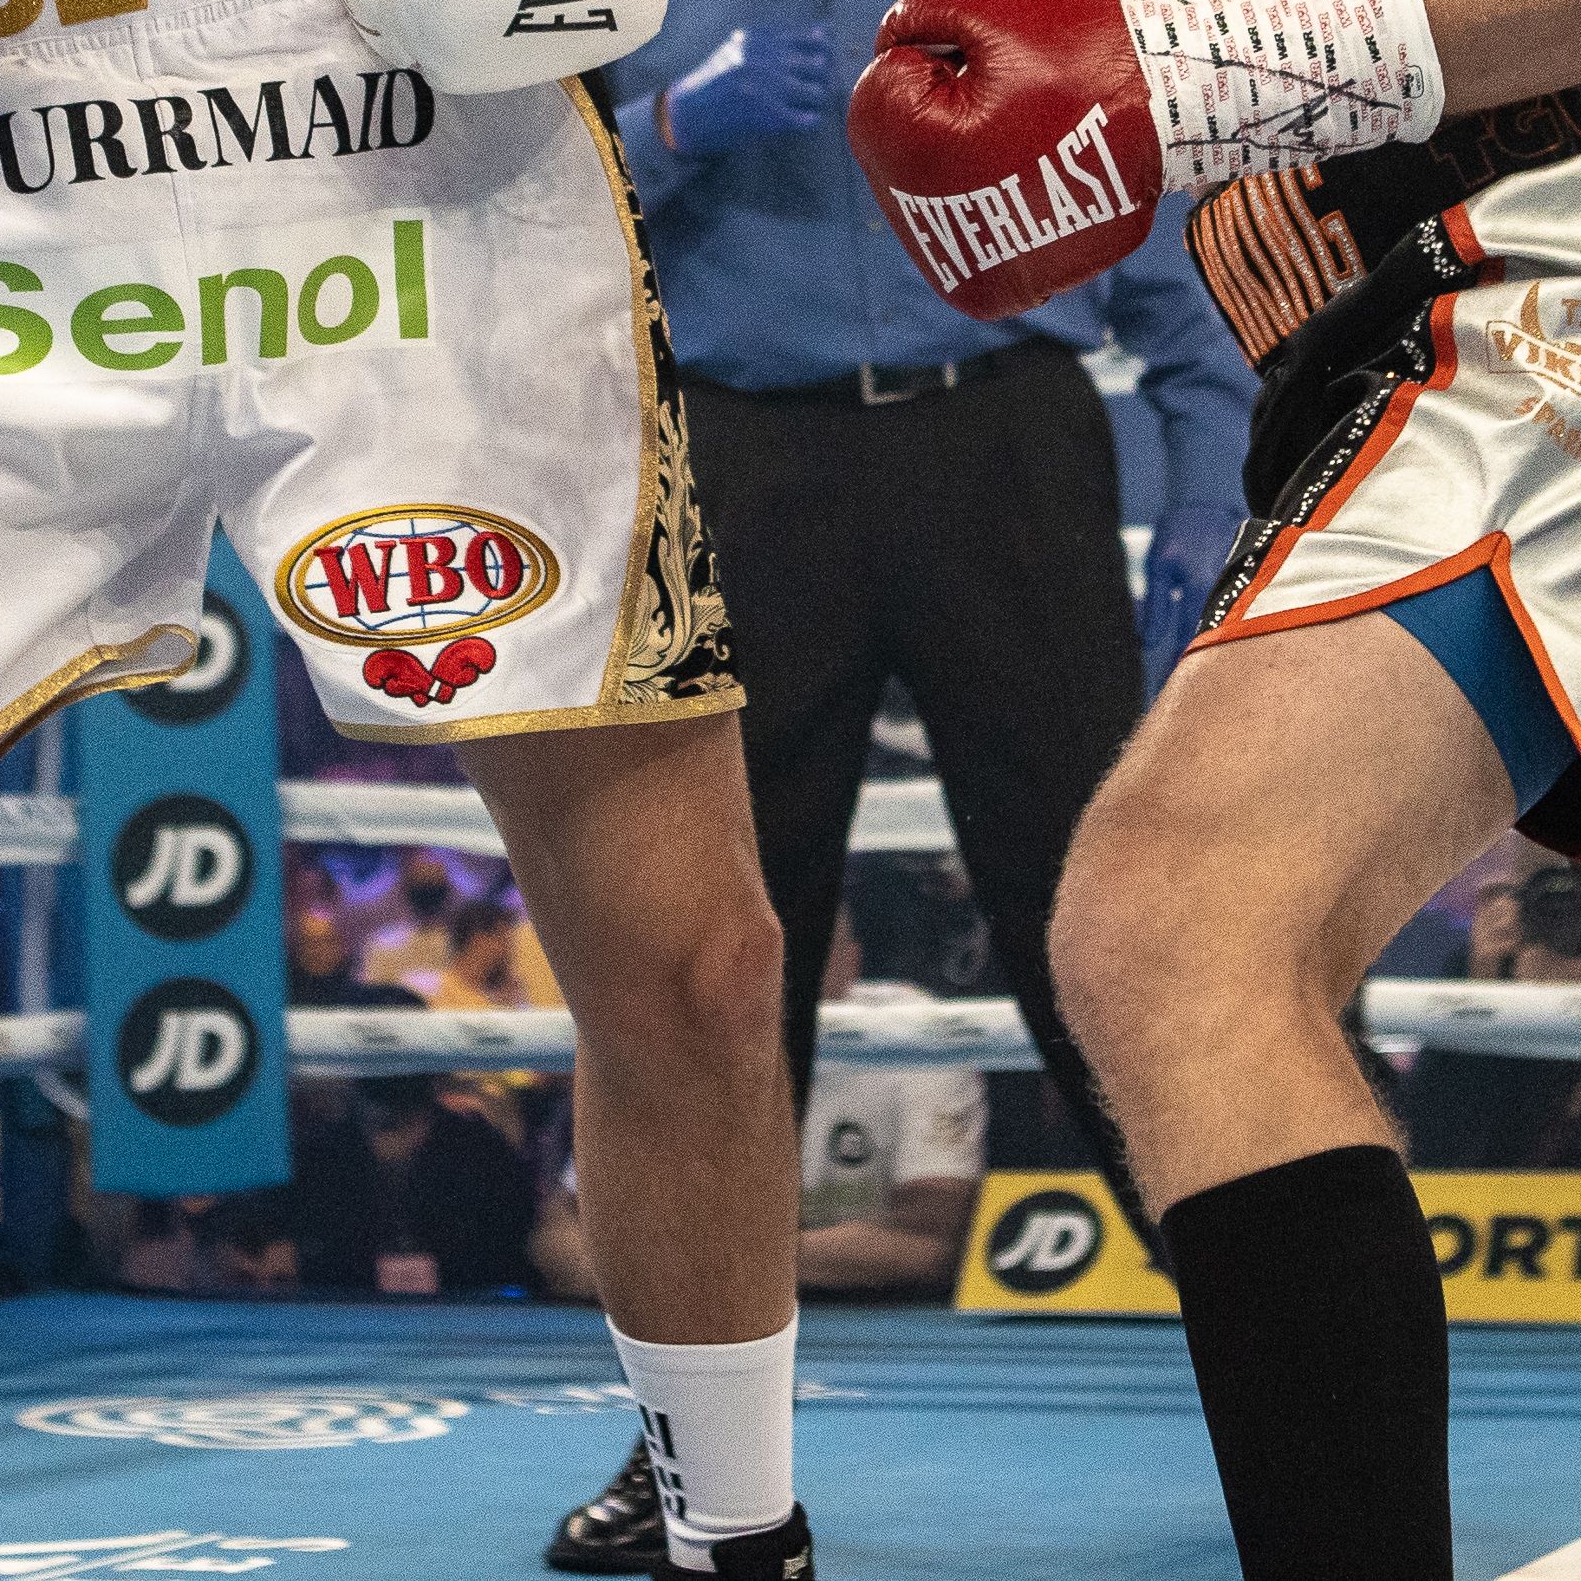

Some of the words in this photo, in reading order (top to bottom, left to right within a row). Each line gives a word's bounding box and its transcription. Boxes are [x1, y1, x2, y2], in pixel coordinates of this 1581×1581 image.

[890, 103, 1136, 293] EVERLAST
[314, 529, 525, 620] WBO
[125, 823, 242, 910] JD
[131, 1008, 249, 1094] JD
[993, 1209, 1097, 1272] JD
